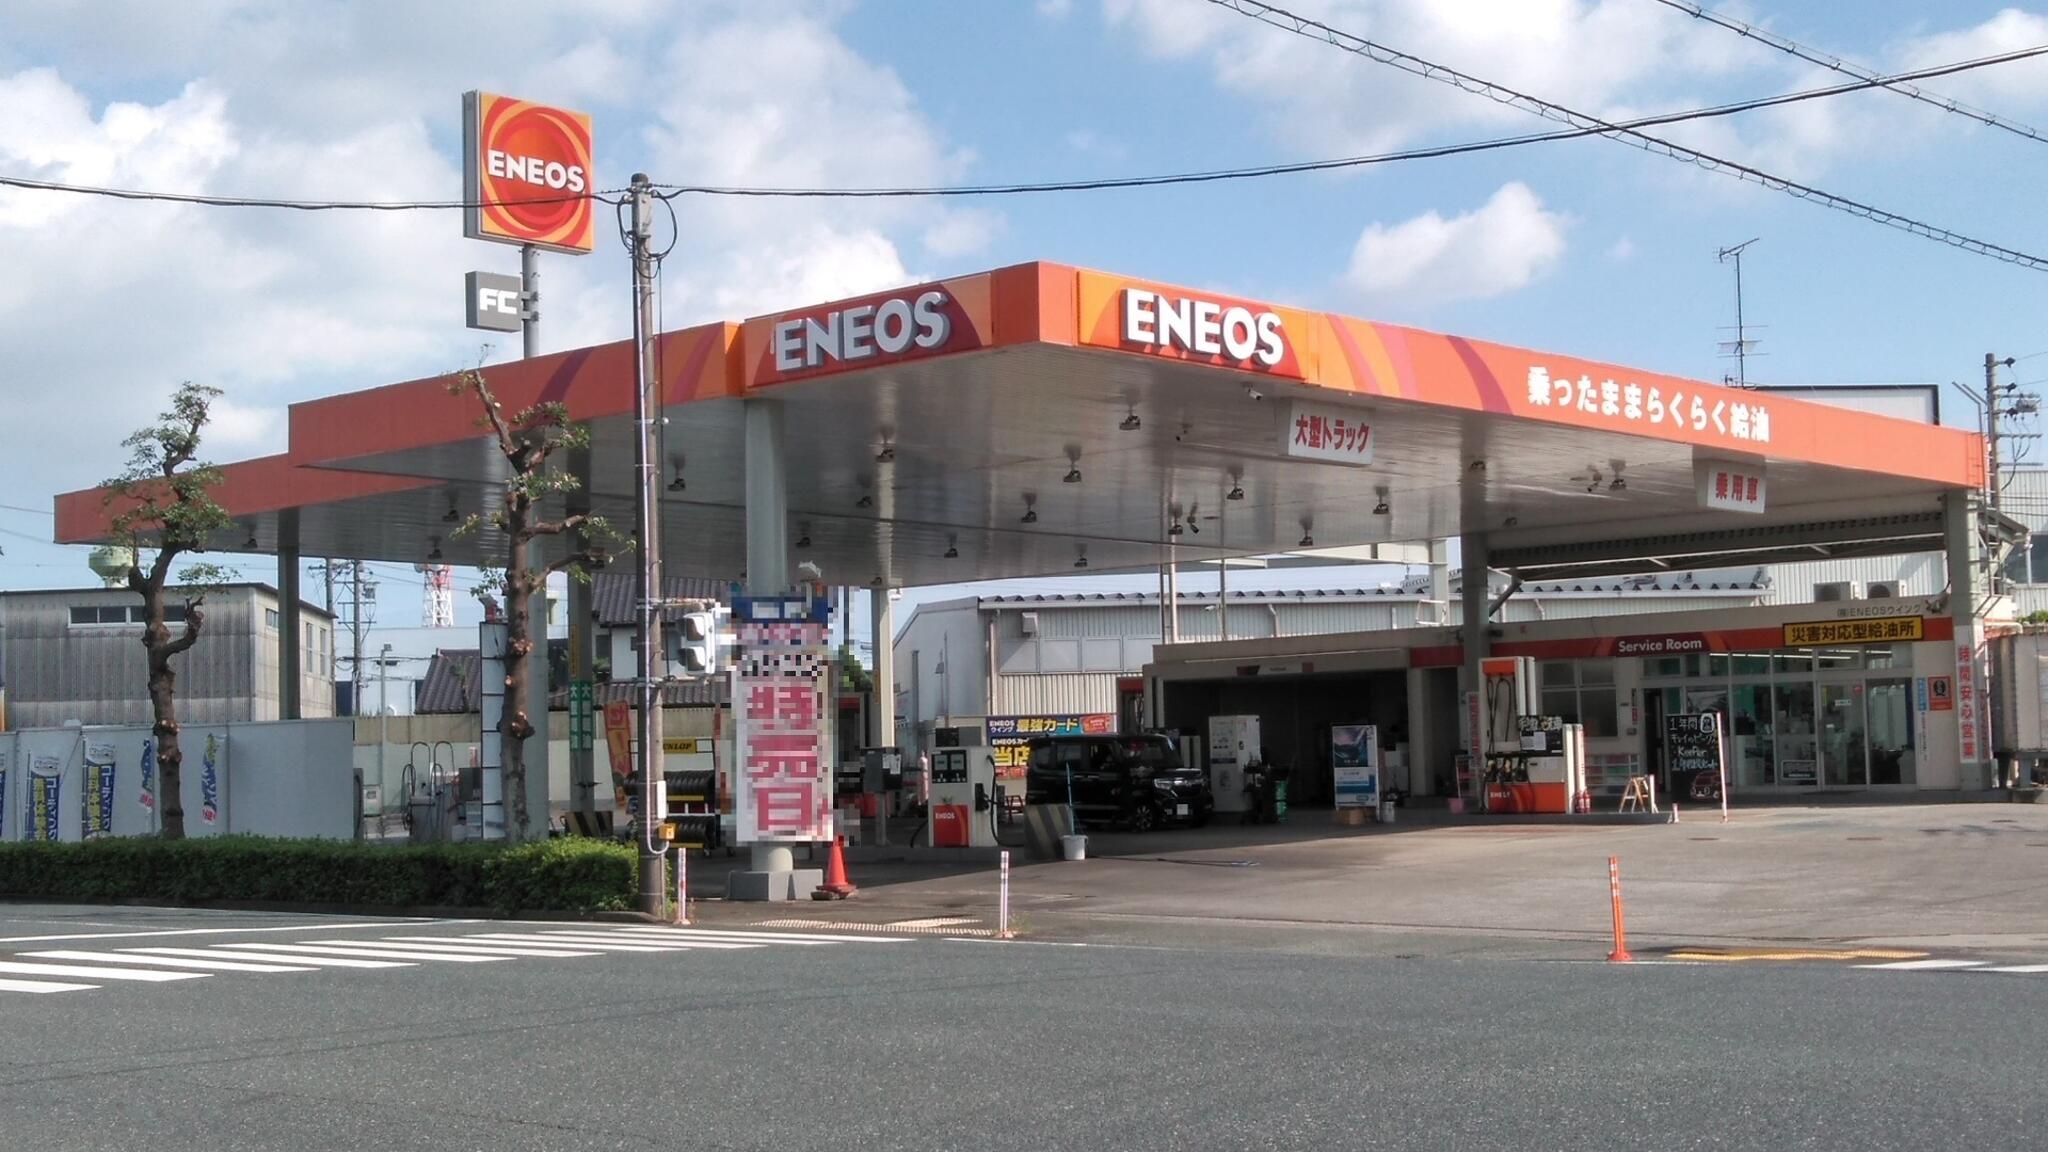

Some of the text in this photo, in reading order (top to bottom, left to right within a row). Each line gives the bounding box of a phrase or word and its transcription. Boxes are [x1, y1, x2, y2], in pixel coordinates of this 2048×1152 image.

[488, 148, 586, 194] ENEOS
[480, 287, 518, 315] FC
[775, 291, 949, 373] ENEOS
[1122, 287, 1283, 366] ENEOS
[1526, 365, 1770, 442] 乗ったままらくらく給油
[1294, 412, 1370, 455] 大型トラック
[1715, 471, 1759, 504] 乗用車
[1618, 638, 1702, 653] Service Room
[1791, 619, 1915, 642] 災害対応型給油所
[1016, 717, 1078, 733] 最強カード
